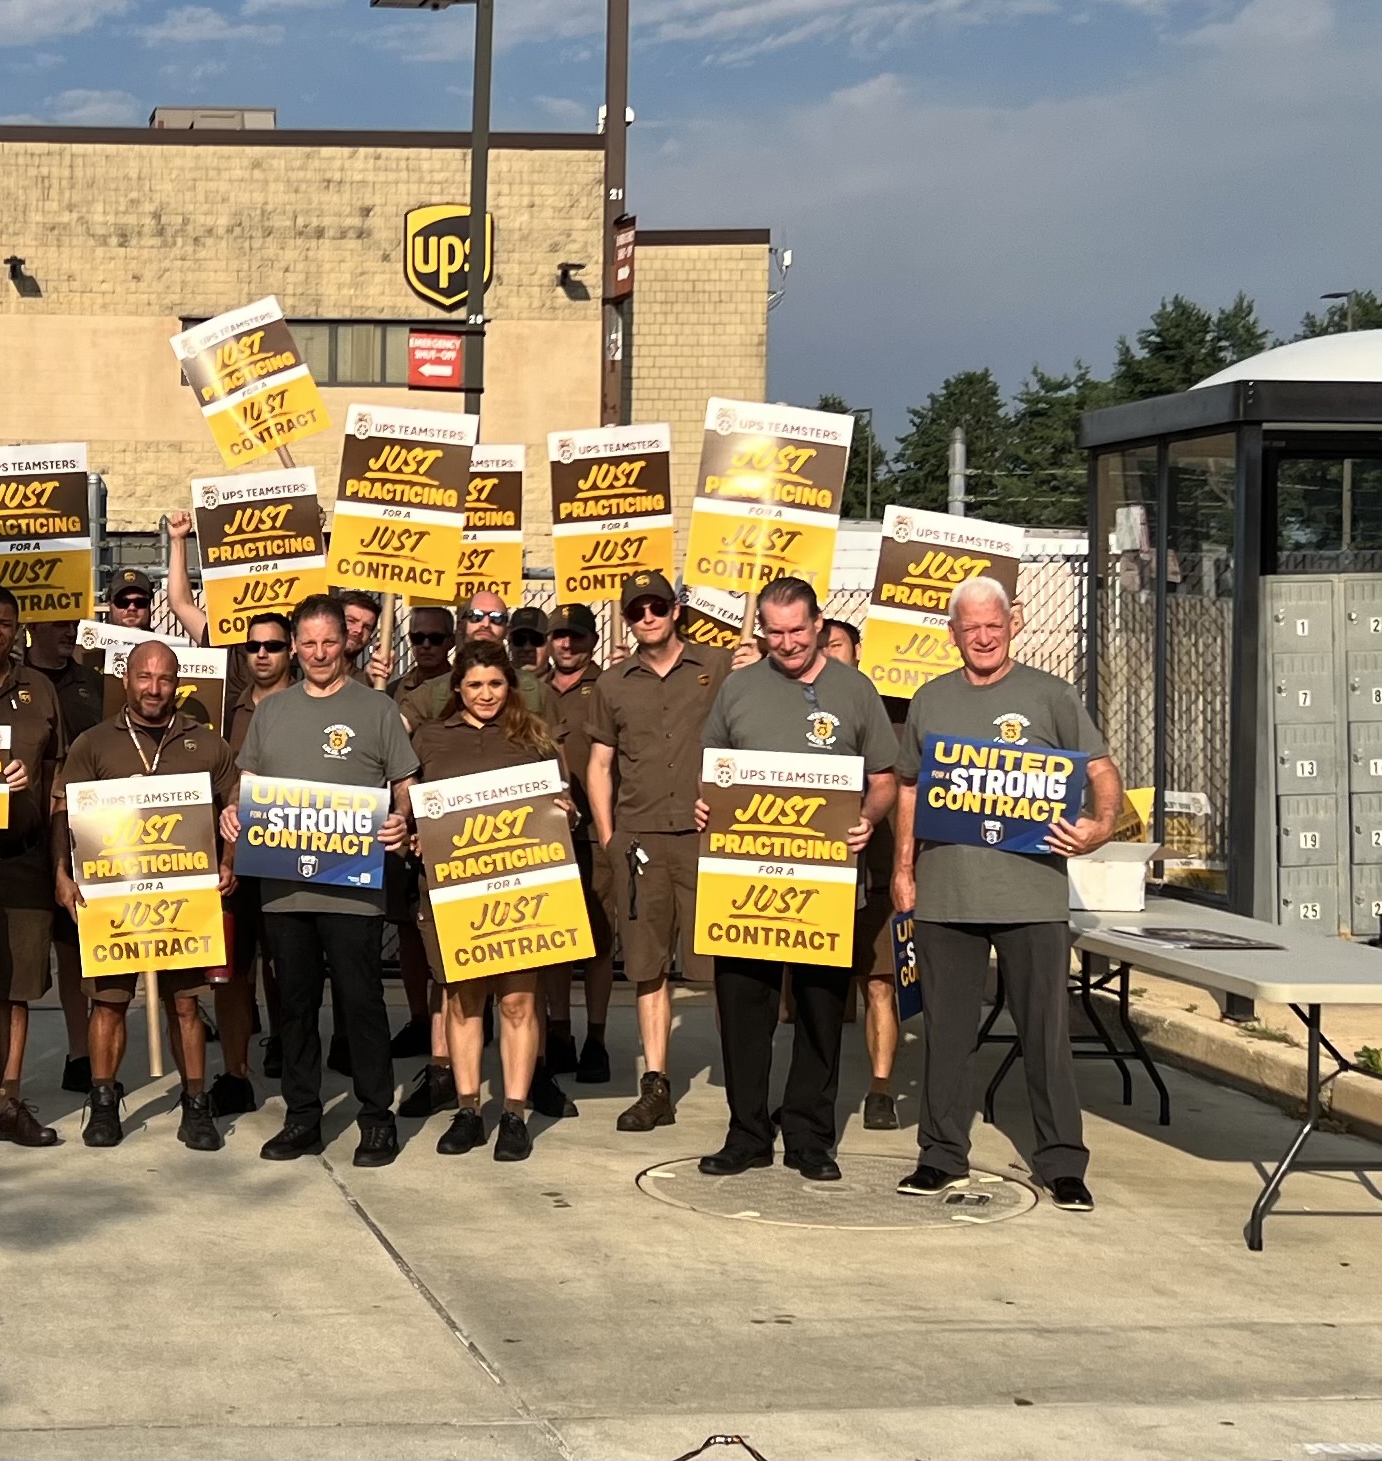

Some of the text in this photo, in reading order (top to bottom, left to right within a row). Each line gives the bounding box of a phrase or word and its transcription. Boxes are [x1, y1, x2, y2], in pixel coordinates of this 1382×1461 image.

[609, 189, 623, 200] 21
[375, 424, 395, 435] UPS
[740, 421, 763, 430] UPS
[368, 445, 443, 475] JUST
[578, 444, 601, 455] UPS
[577, 460, 646, 489] JUST
[222, 489, 244, 500] UPS
[345, 480, 458, 508] PRACTICING
[559, 495, 665, 519] PRACTICING
[224, 504, 293, 534] JUST
[382, 509, 411, 519] FOR A
[10, 542, 40, 551] FOR A
[360, 525, 430, 553] JUST
[723, 525, 803, 552] JUST
[917, 528, 940, 539] UPS
[207, 536, 315, 562] PRACTICING
[581, 537, 647, 563] JUST
[337, 559, 445, 587] CONTRACT
[908, 551, 991, 582] JUST
[233, 577, 300, 604] JUST
[696, 598, 715, 611] UPS
[1300, 622, 1305, 633] 1
[1373, 620, 1380, 632] 2
[1302, 693, 1307, 705] 7
[1375, 690, 1381, 702] 8
[935, 742, 1074, 777] UNITED
[1300, 763, 1314, 776] 13
[740, 770, 766, 781] UPS
[950, 768, 1066, 800] STRONG
[101, 796, 125, 807] UPS
[252, 783, 377, 811] UNITED
[447, 792, 473, 807] UPS
[734, 793, 827, 825] JUST
[928, 786, 1067, 823] CONTRACT
[102, 814, 182, 845] JUST
[268, 808, 372, 833] STRONG
[452, 805, 533, 848] JUST
[248, 826, 373, 856] CONTRACT
[709, 833, 847, 862] PRACTICING
[1303, 834, 1317, 847] 19
[83, 851, 208, 880] PRACTICING
[435, 844, 566, 882] PRACTICING
[758, 865, 795, 876] FOR A
[130, 882, 163, 892] FOR A
[487, 878, 521, 890] FOR A
[470, 893, 549, 930] JUST
[731, 885, 819, 915] JUST
[1303, 905, 1318, 918] 25
[111, 898, 190, 929] JUST
[93, 935, 212, 963] CONTRACT
[454, 929, 579, 967] CONTRACT
[708, 923, 840, 952] CONTRACT
